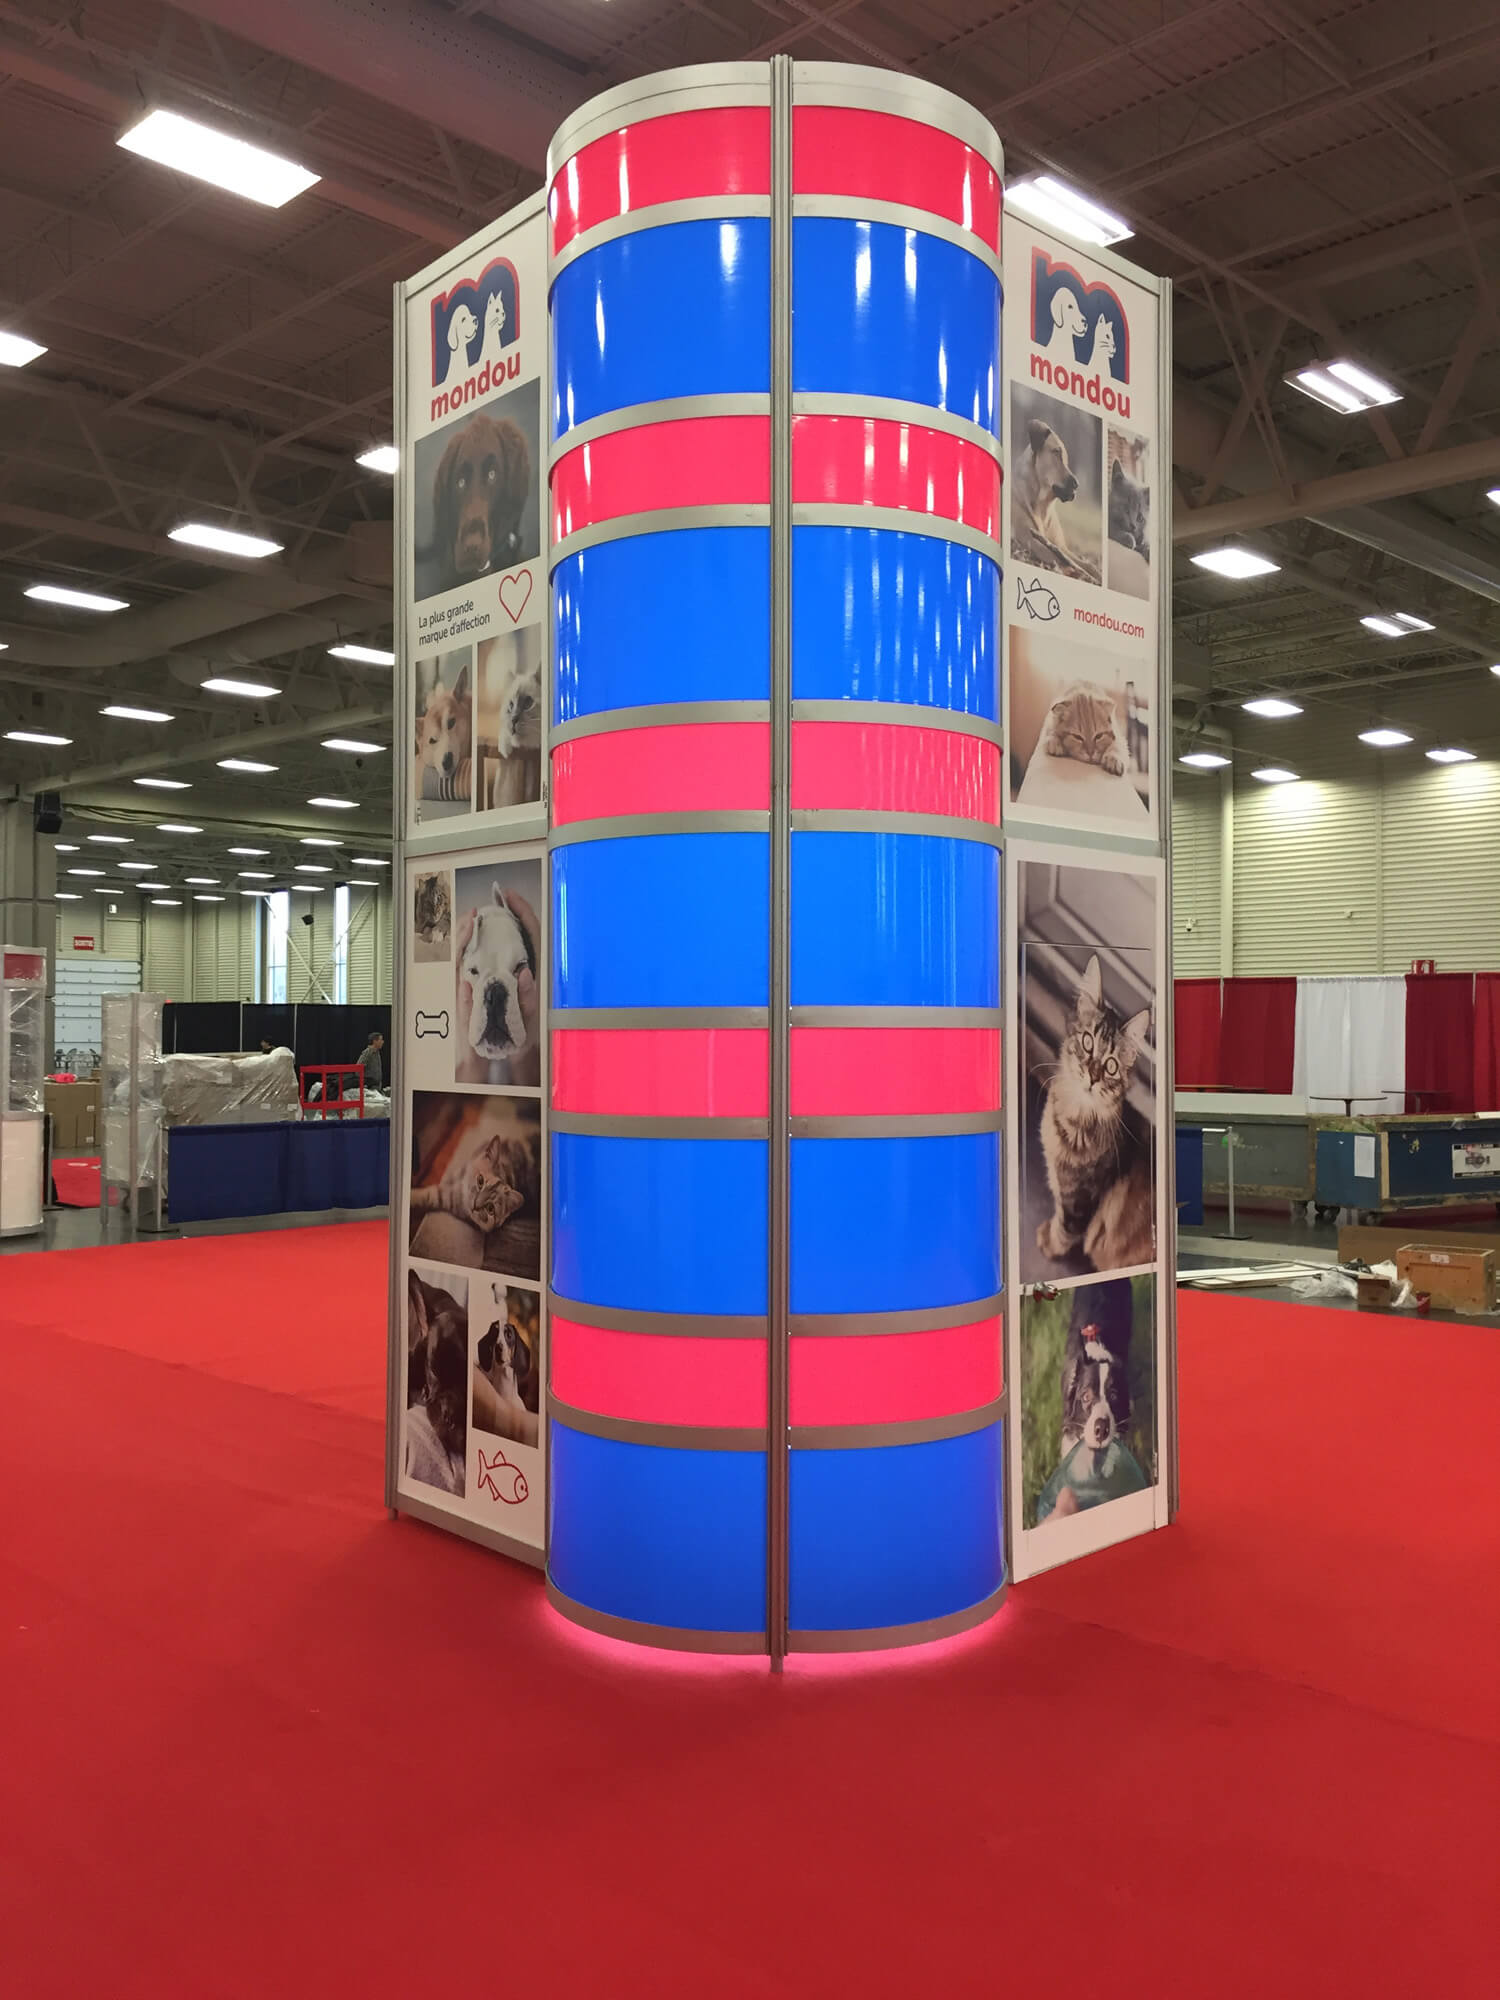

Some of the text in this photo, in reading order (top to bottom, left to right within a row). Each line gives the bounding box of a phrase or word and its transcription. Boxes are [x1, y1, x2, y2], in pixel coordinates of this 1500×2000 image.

[431, 351, 521, 421] mondou
[1030, 353, 1131, 419] mondou
[418, 600, 474, 628] La plus grande
[1073, 607, 1145, 639] mondou.com
[419, 628, 448, 646] marque
